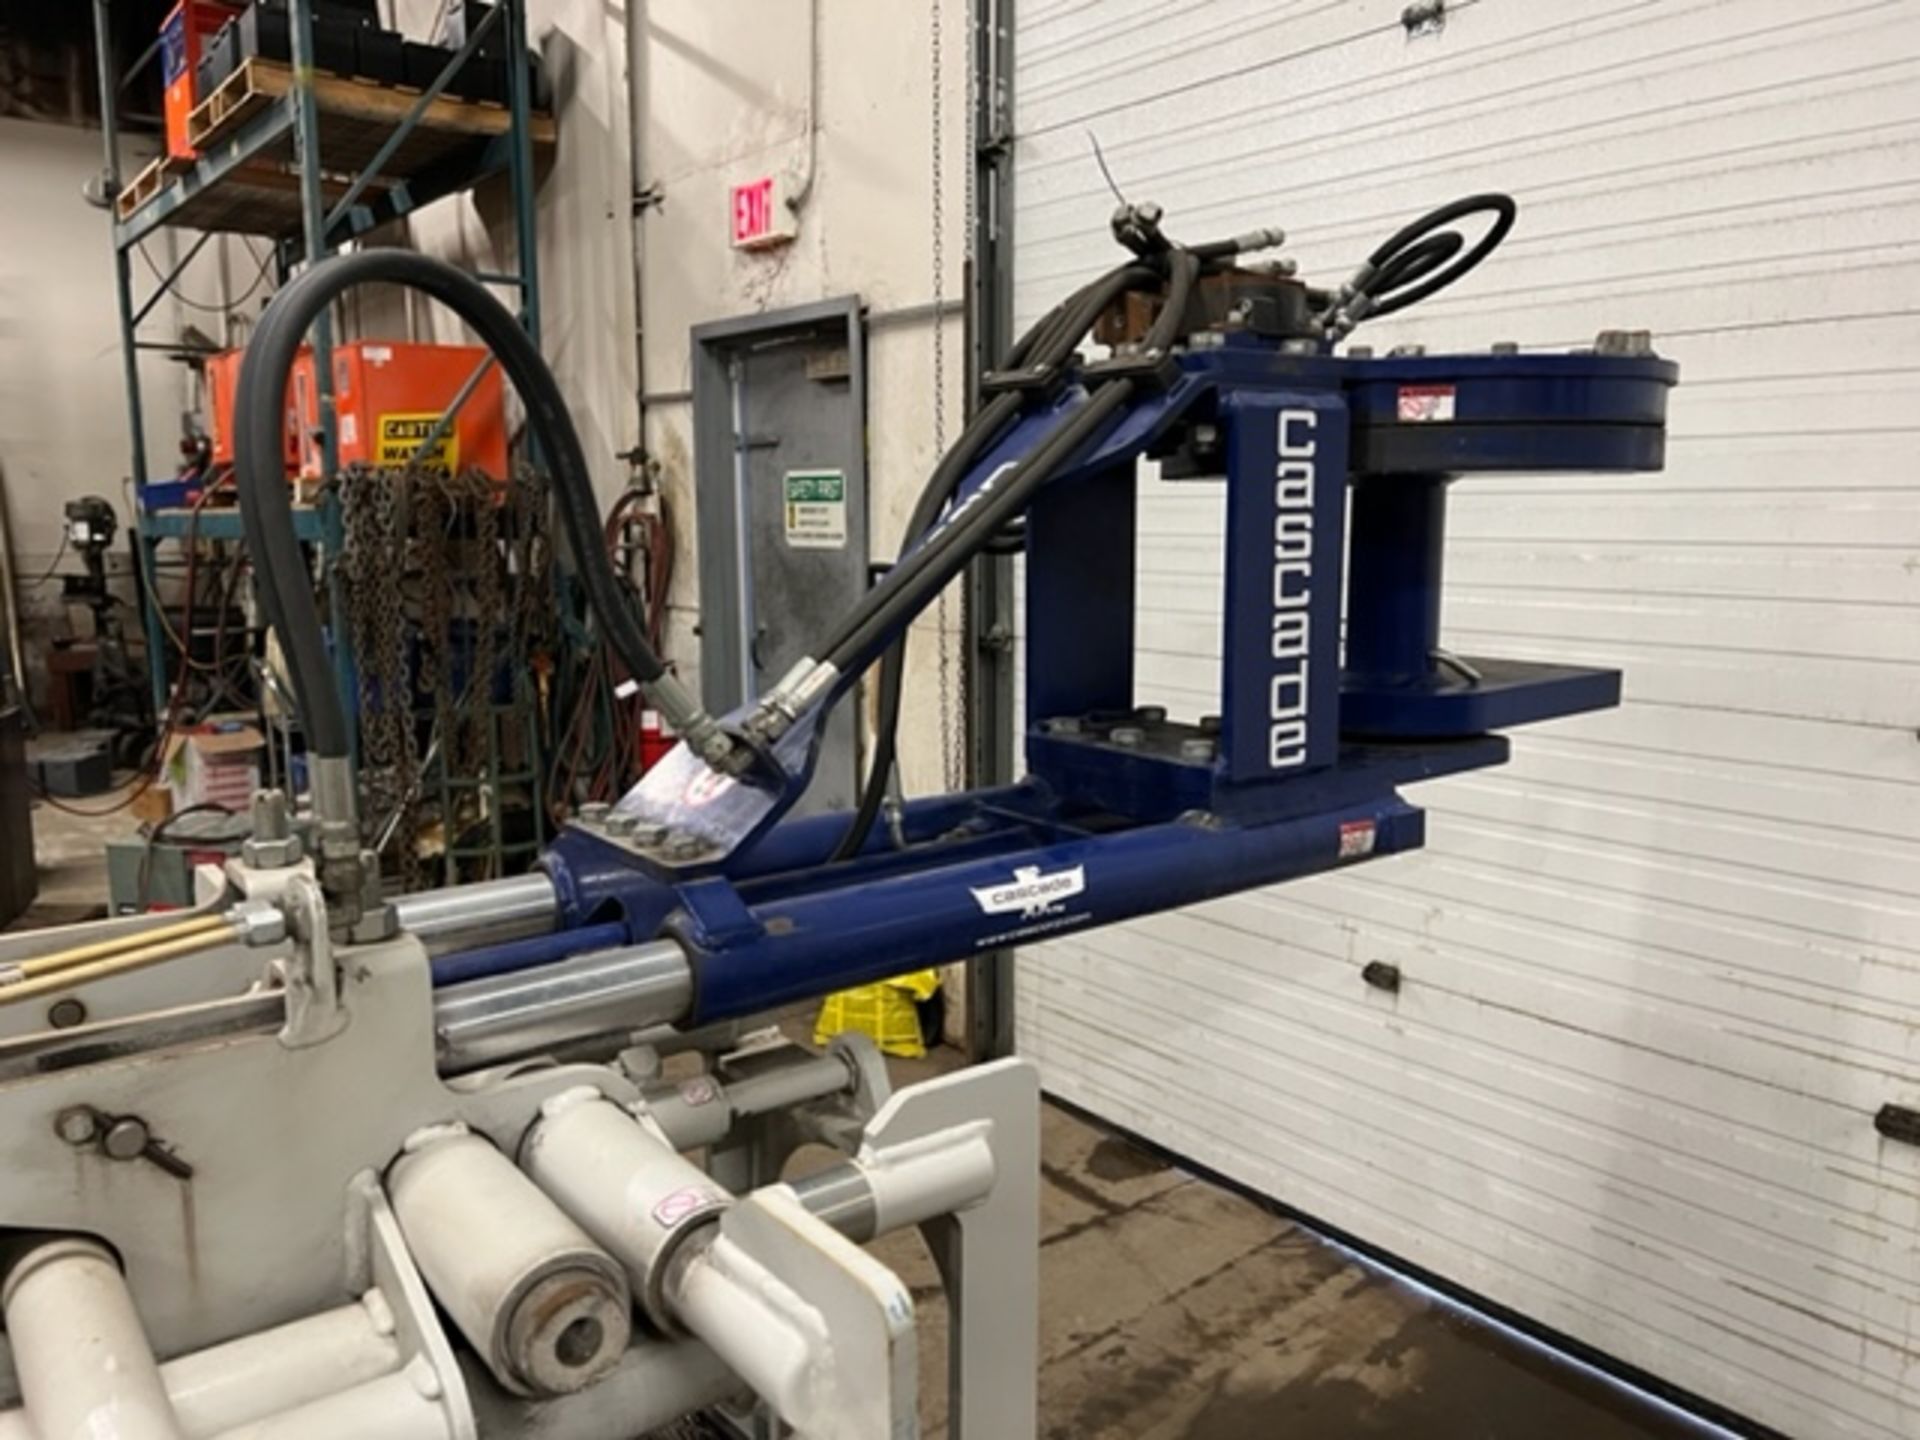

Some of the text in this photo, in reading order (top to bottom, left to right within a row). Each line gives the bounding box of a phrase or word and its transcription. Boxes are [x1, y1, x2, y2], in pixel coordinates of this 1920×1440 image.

[736, 179, 772, 240] EXIT
[1269, 409, 1317, 768] cascade
[992, 877, 1073, 906] cascade
